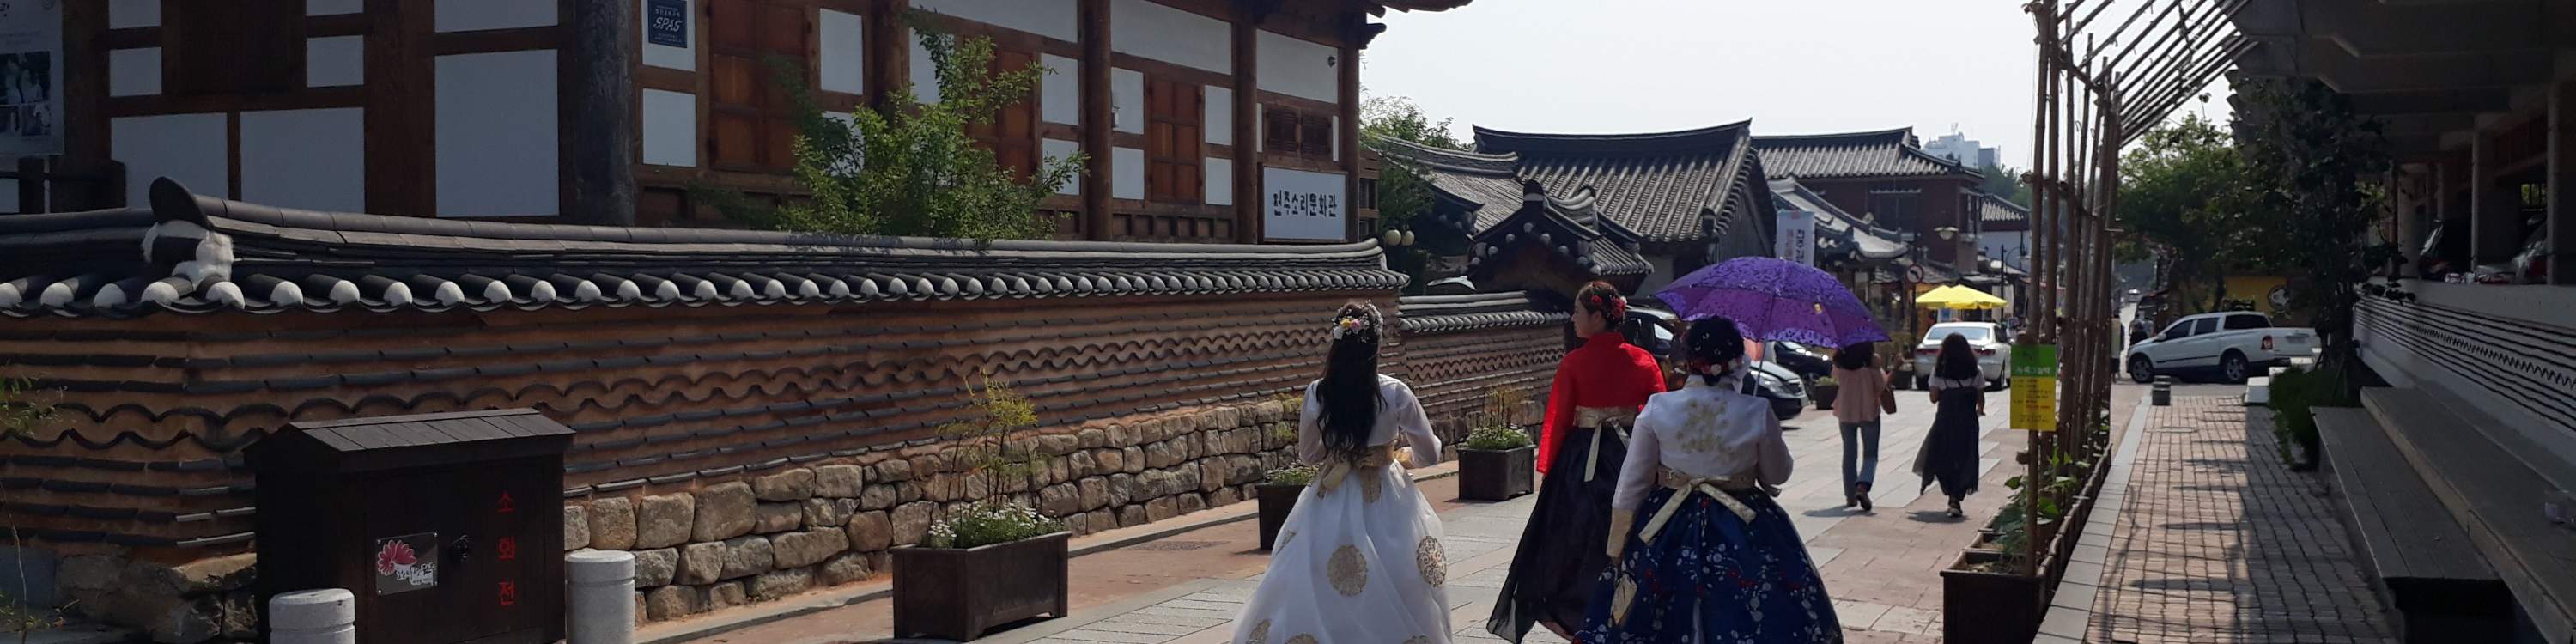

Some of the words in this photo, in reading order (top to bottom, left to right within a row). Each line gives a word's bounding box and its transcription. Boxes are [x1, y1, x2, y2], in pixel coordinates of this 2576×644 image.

[653, 16, 683, 32] SPAS
[1273, 189, 1337, 217] 전주소리문화관
[498, 490, 515, 605] 소화전
